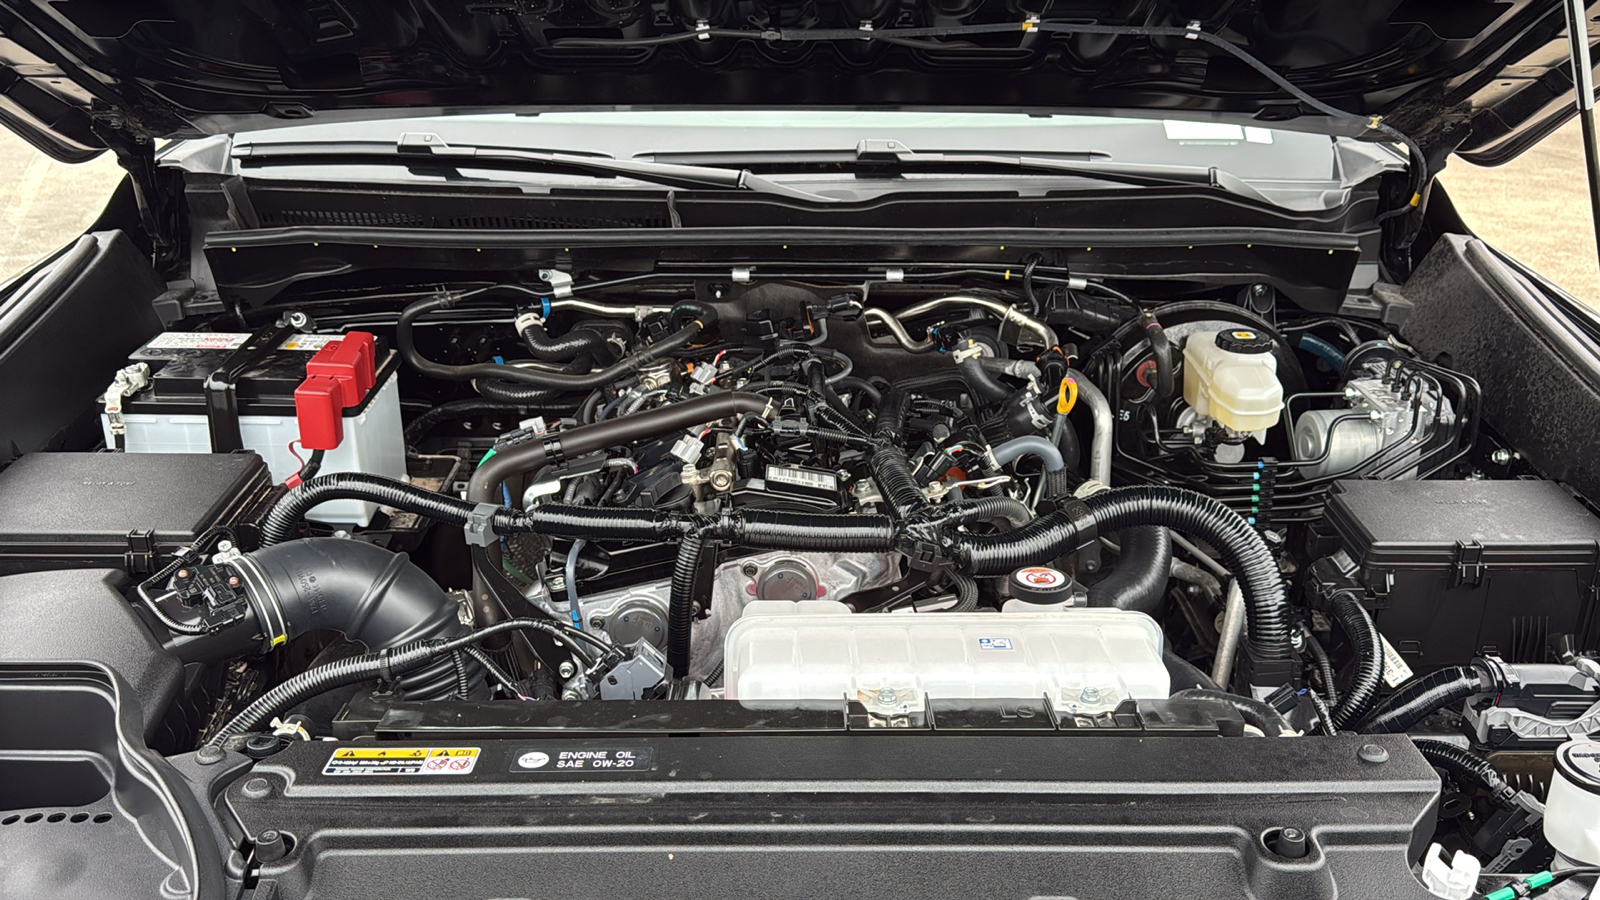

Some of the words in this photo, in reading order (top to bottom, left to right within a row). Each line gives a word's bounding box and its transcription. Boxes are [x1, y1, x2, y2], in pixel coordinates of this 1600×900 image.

[558, 751, 608, 760] ENGINE
[615, 751, 637, 760] OIL
[556, 760, 584, 768] SAE
[592, 760, 635, 768] 0W-20
